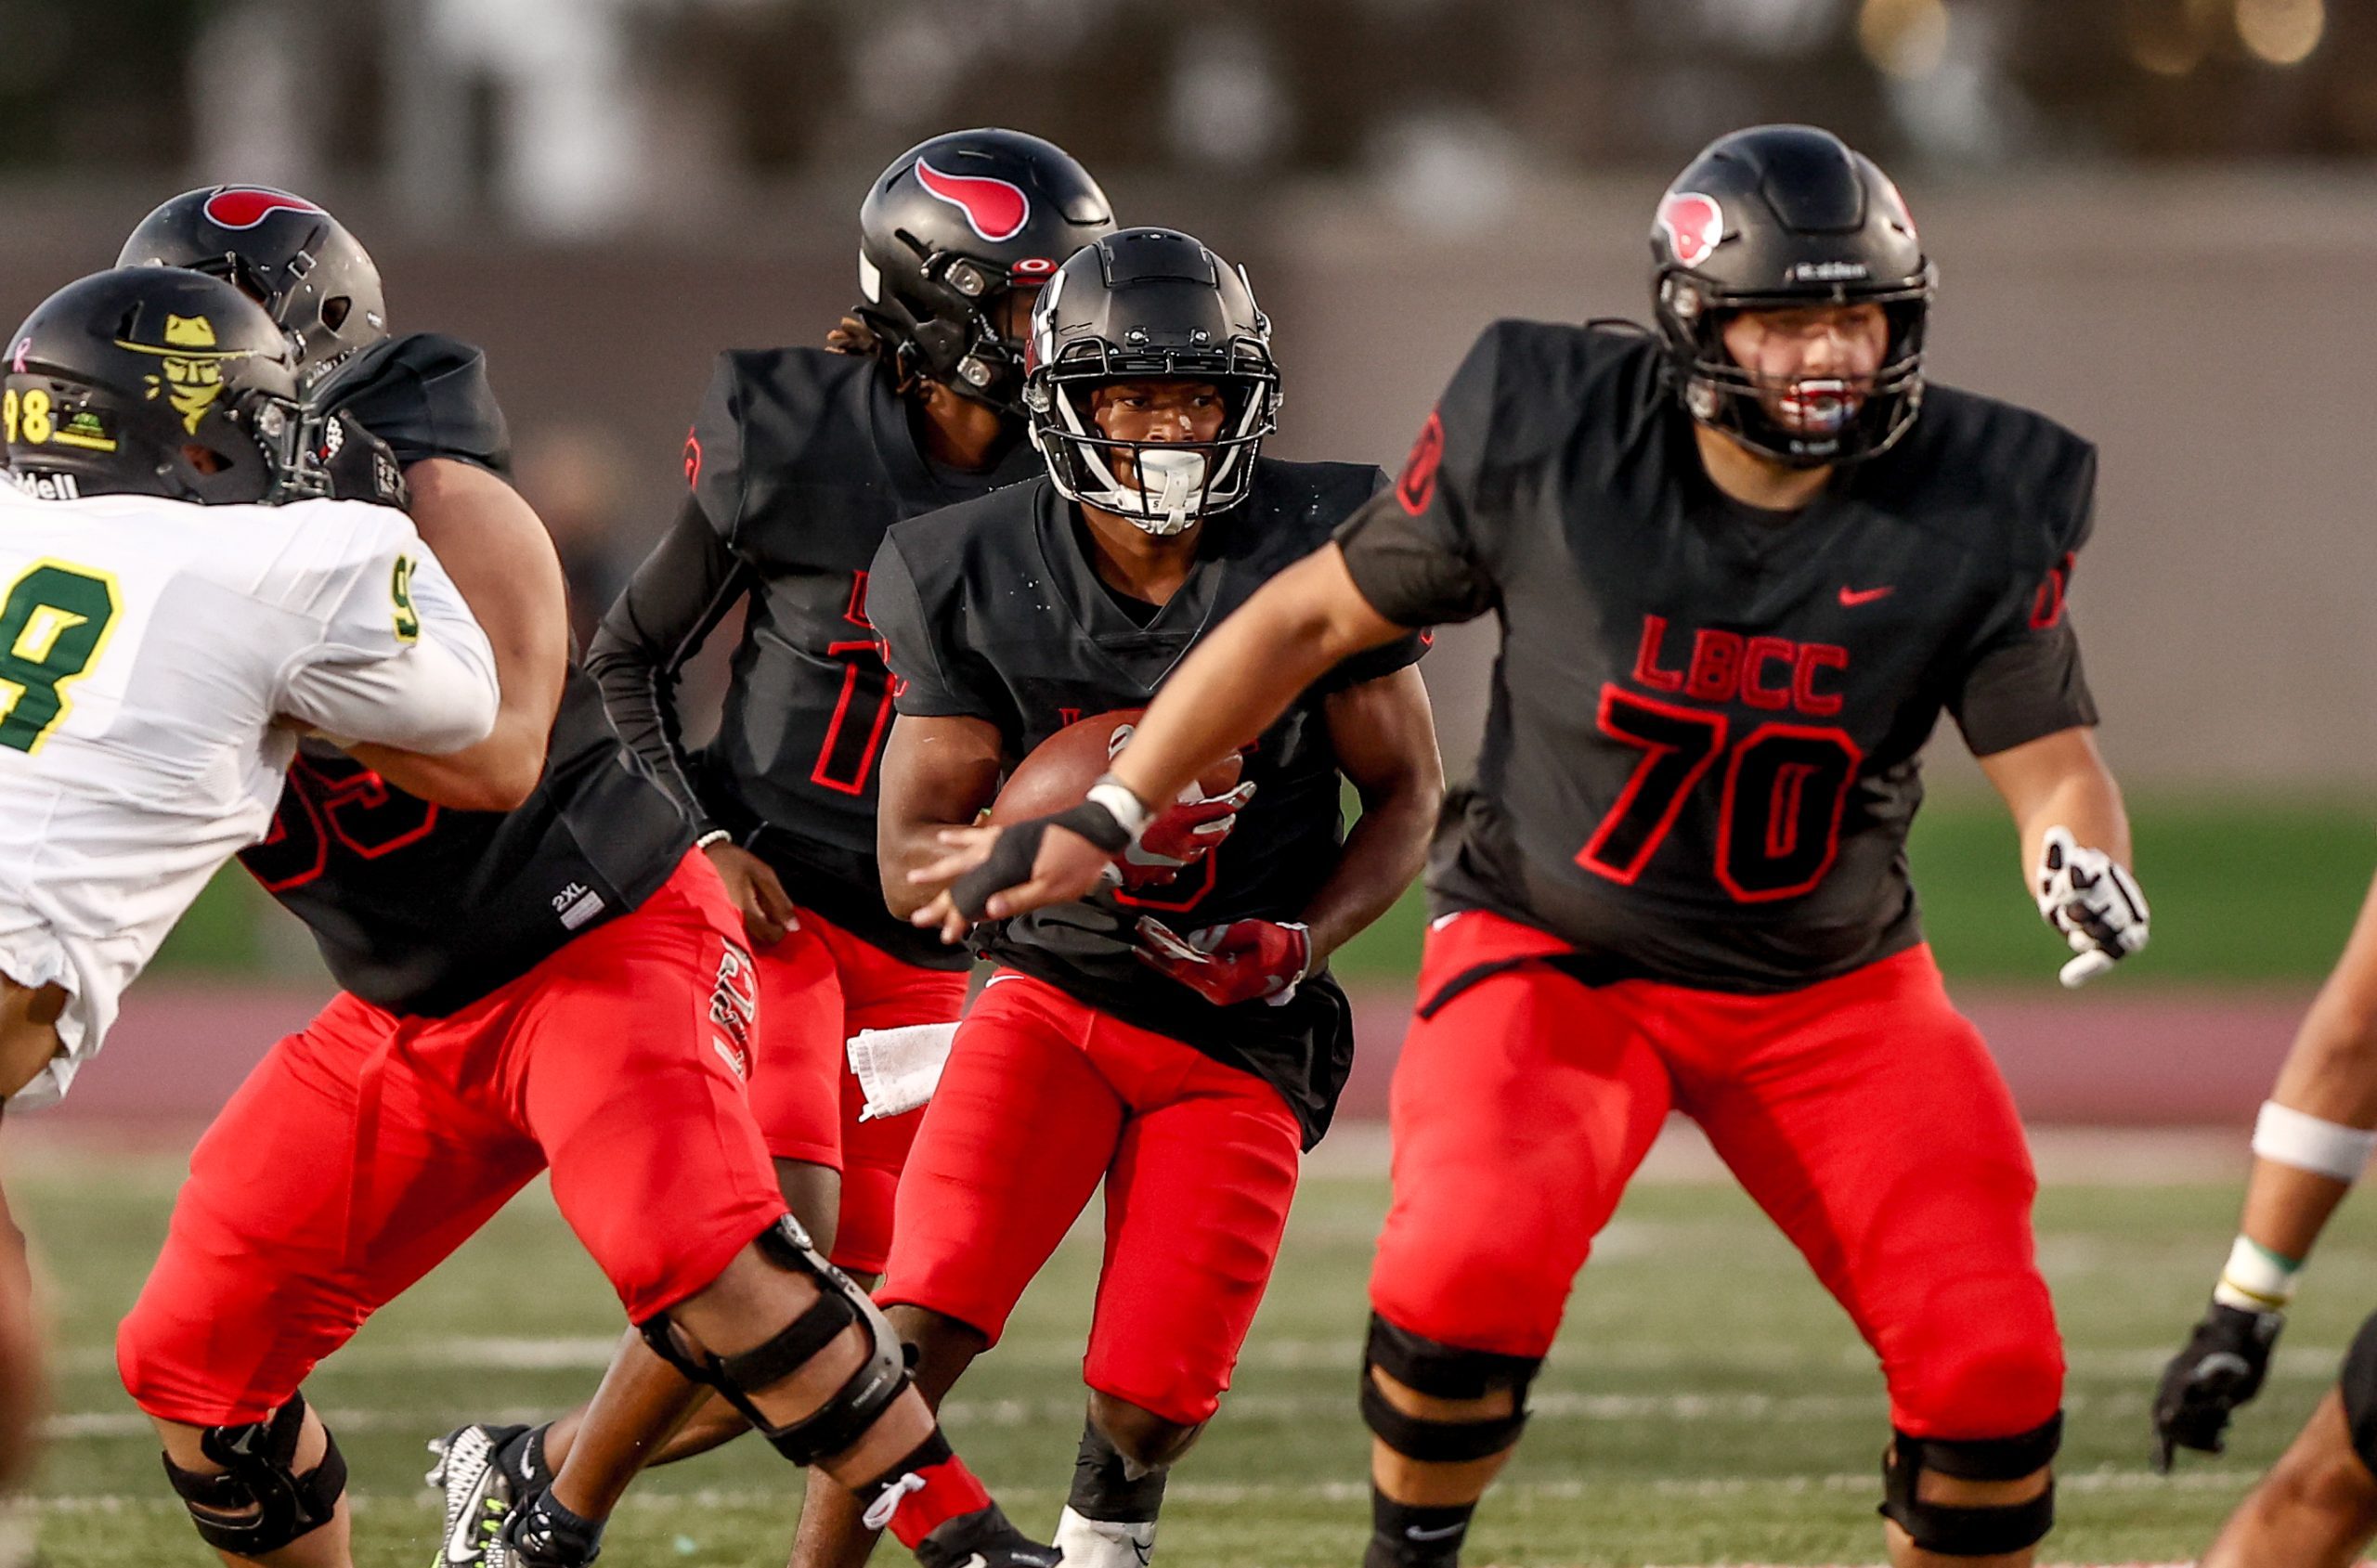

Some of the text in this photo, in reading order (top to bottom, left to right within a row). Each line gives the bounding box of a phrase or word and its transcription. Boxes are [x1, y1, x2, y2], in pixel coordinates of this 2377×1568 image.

[3, 388, 52, 446] 98
[1631, 613, 1850, 716] LBCC
[1574, 680, 1863, 903] 70
[552, 882, 588, 913] 2XL
